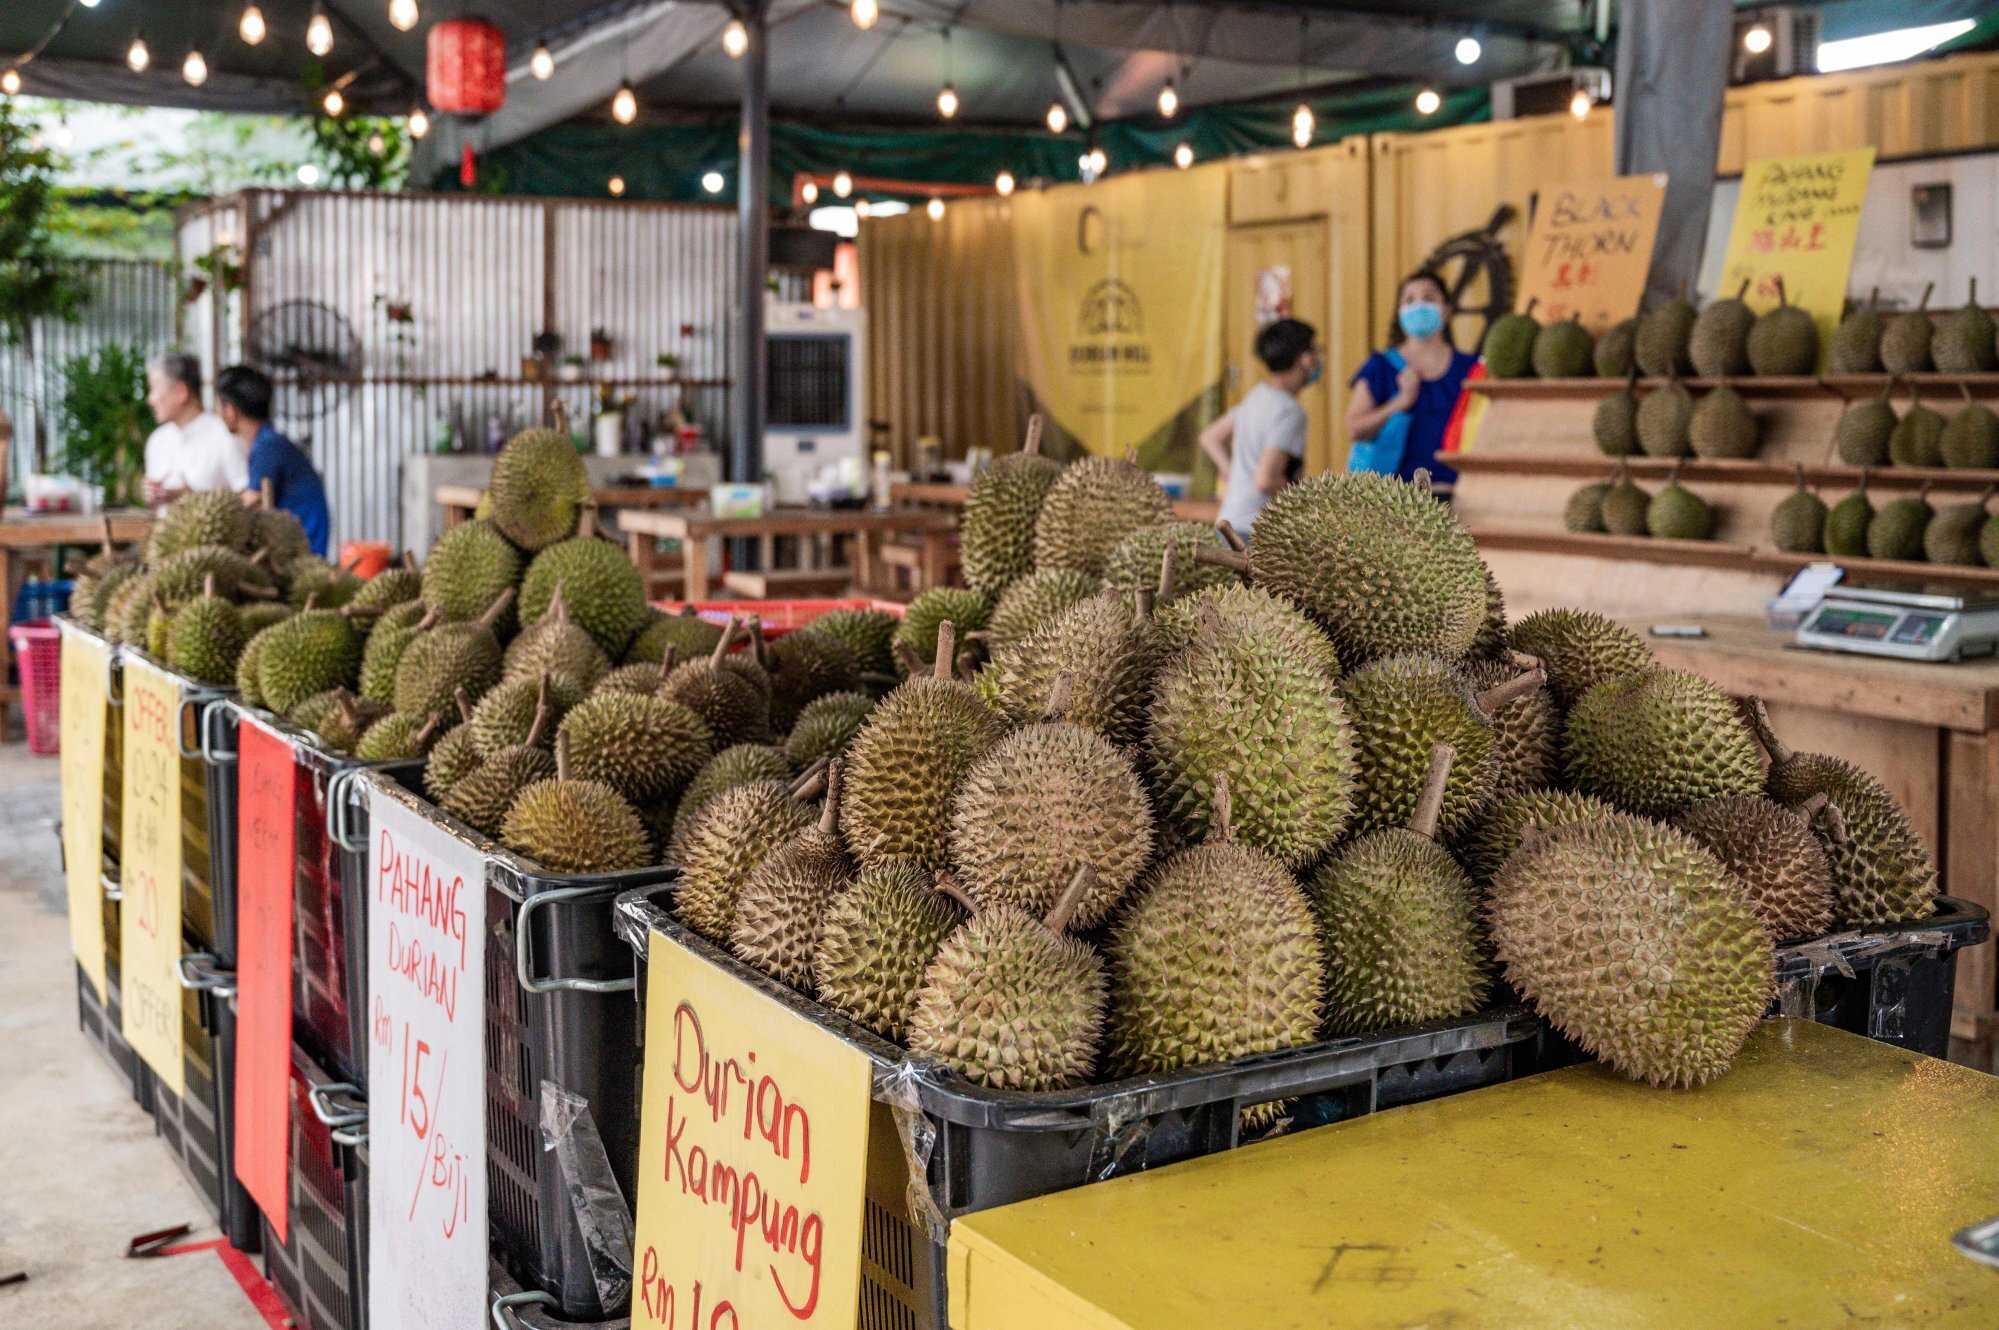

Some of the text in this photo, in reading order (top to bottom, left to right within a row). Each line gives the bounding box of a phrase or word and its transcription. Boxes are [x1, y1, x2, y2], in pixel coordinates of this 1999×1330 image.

[1540, 229, 1640, 268] THORN
[1551, 191, 1643, 228] BLACK
[378, 828, 467, 972] PAHANG
[387, 921, 458, 1024] DURIAN
[673, 1001, 811, 1184] Durian
[664, 1094, 824, 1321] Kampung
